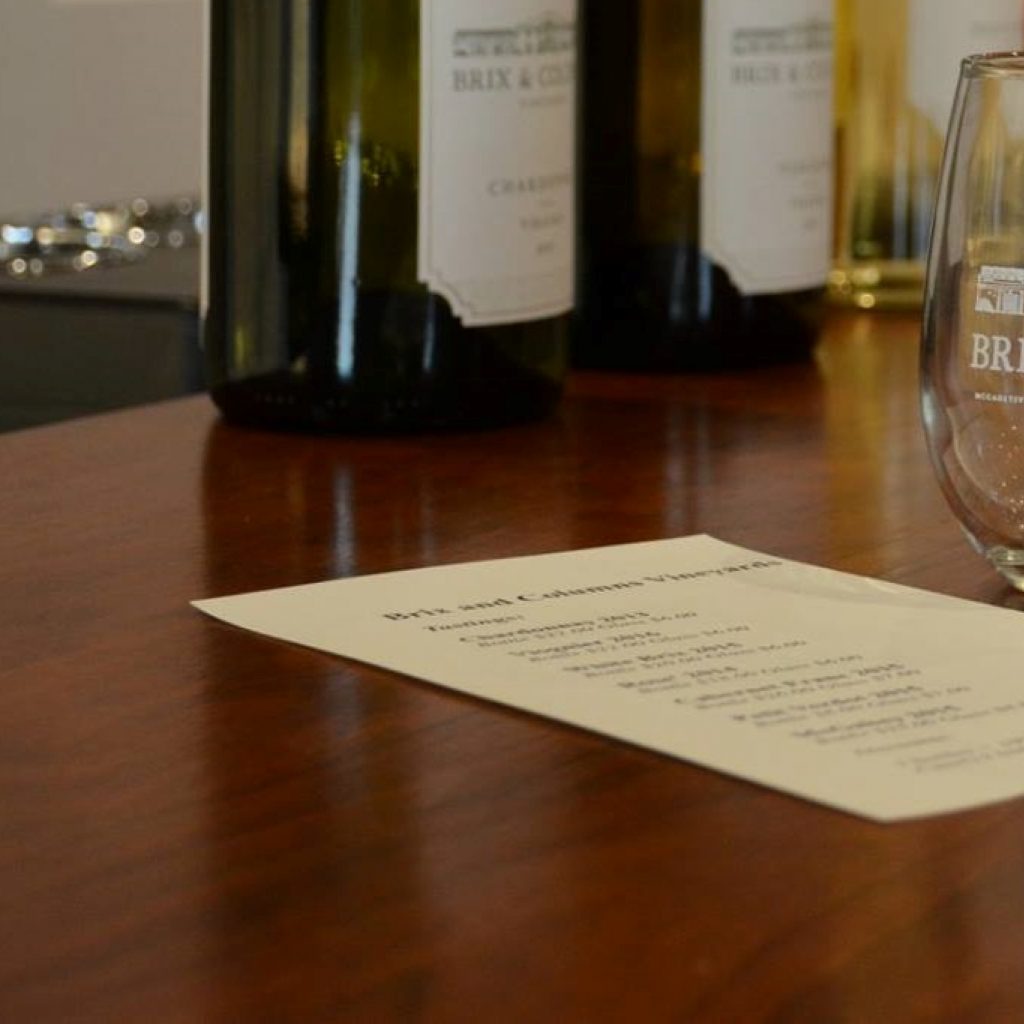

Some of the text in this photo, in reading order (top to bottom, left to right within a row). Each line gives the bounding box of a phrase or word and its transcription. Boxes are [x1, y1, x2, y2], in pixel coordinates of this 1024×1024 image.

[453, 65, 511, 93] BRIX
[518, 66, 531, 88] &
[383, 562, 781, 621] Brix and Columns Vineyards
[459, 621, 601, 642] Chardonnay
